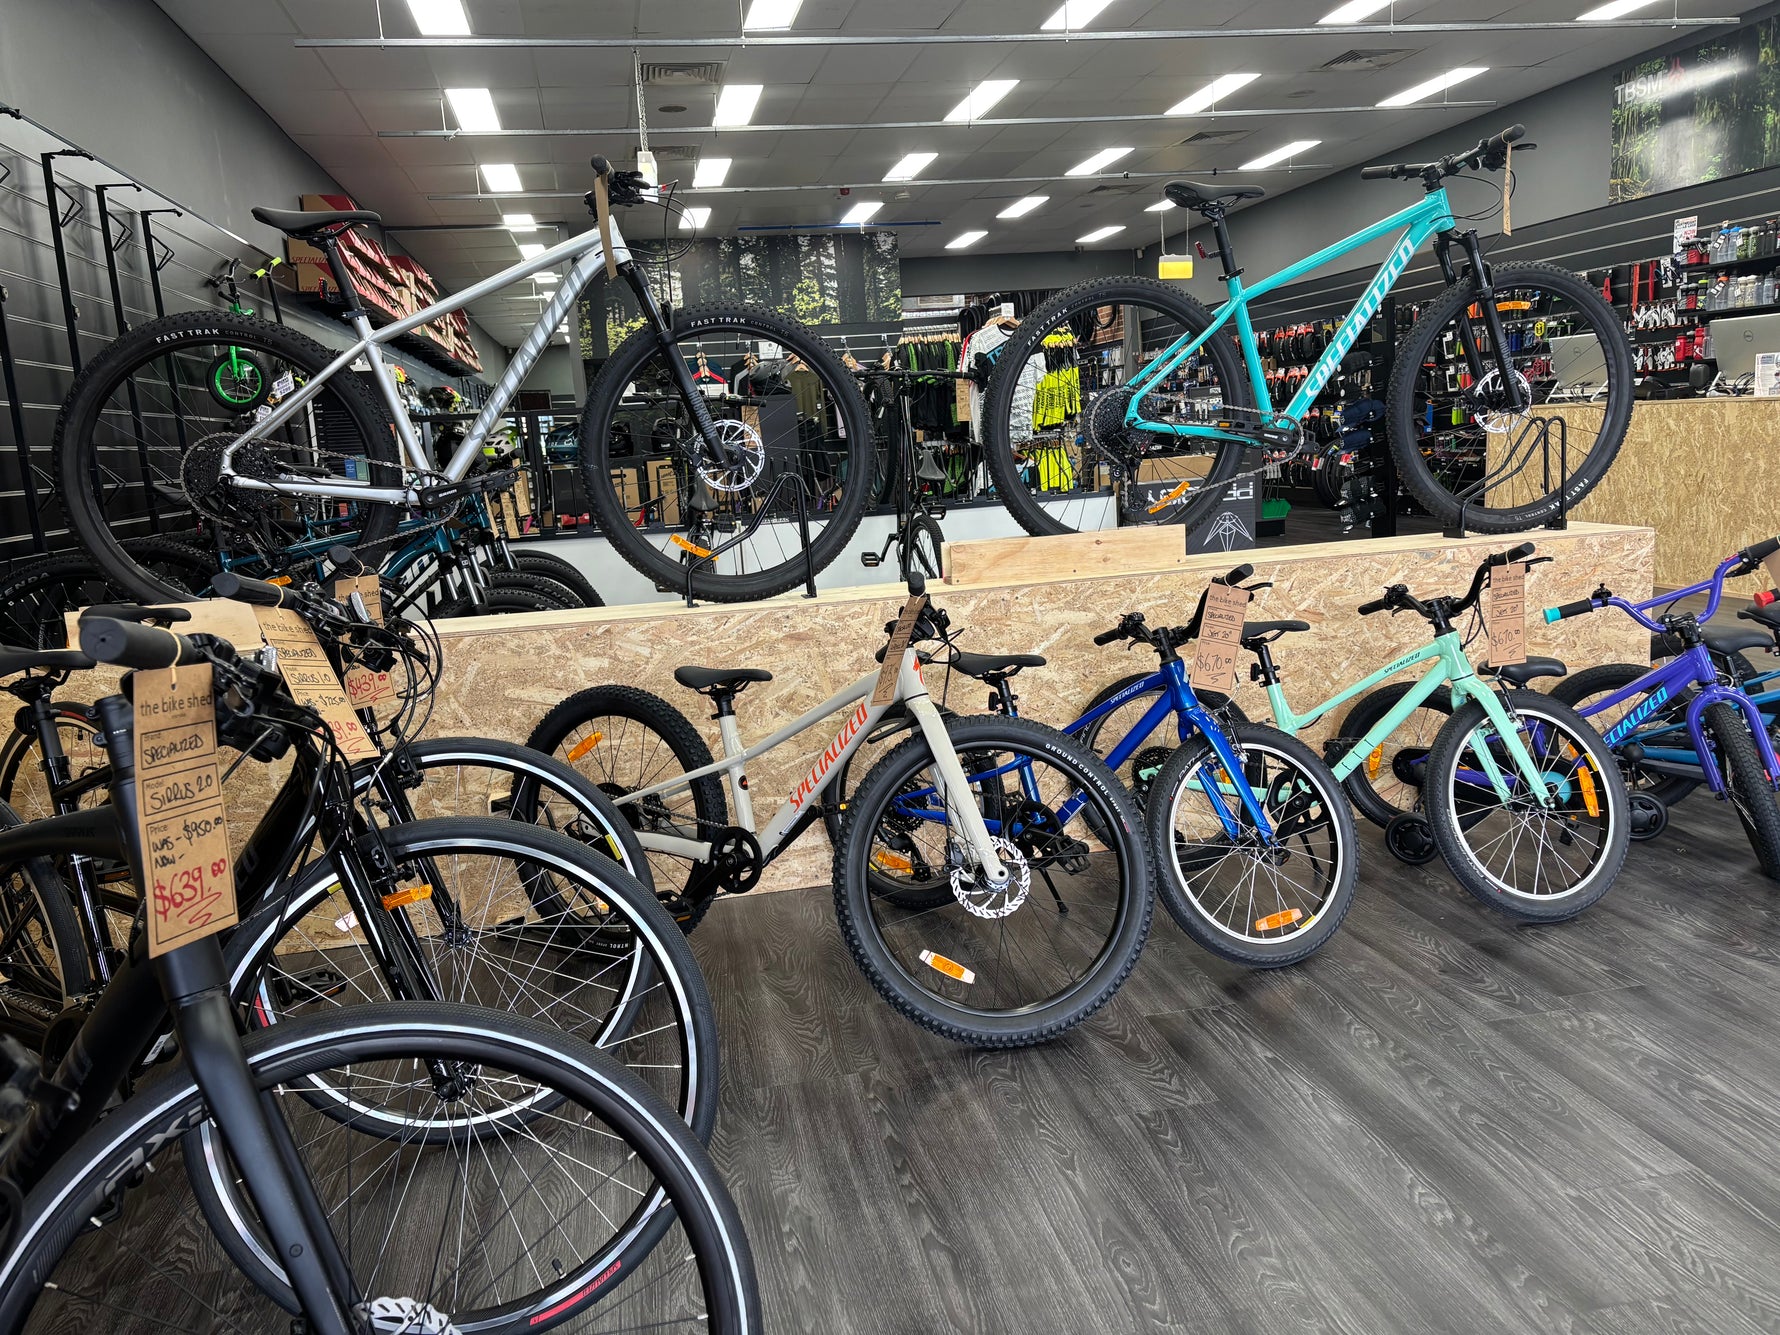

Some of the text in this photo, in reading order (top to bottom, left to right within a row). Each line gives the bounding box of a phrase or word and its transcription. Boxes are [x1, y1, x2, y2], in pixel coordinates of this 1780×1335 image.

[1615, 71, 1663, 105] TBSM
[691, 317, 716, 328] FAST
[718, 316, 746, 324] TRAK
[1027, 325, 1045, 346] FAST
[1046, 307, 1068, 326] TRAK
[1305, 236, 1415, 398] SPECIALIZED
[156, 330, 184, 344] FAST
[187, 328, 220, 337] TRAK
[458, 263, 587, 442] SPECIALIZED
[365, 589, 379, 598] shed
[1209, 594, 1219, 602] the
[1219, 596, 1232, 605] bike
[1233, 600, 1247, 608] shed
[263, 621, 277, 632] the
[278, 623, 295, 633] bike
[140, 691, 213, 717] the bike shed
[789, 702, 868, 813] SPECIALIZED
[1045, 743, 1078, 765] GROUND
[1078, 763, 1109, 796] CONTROL
[150, 824, 168, 835] Price
